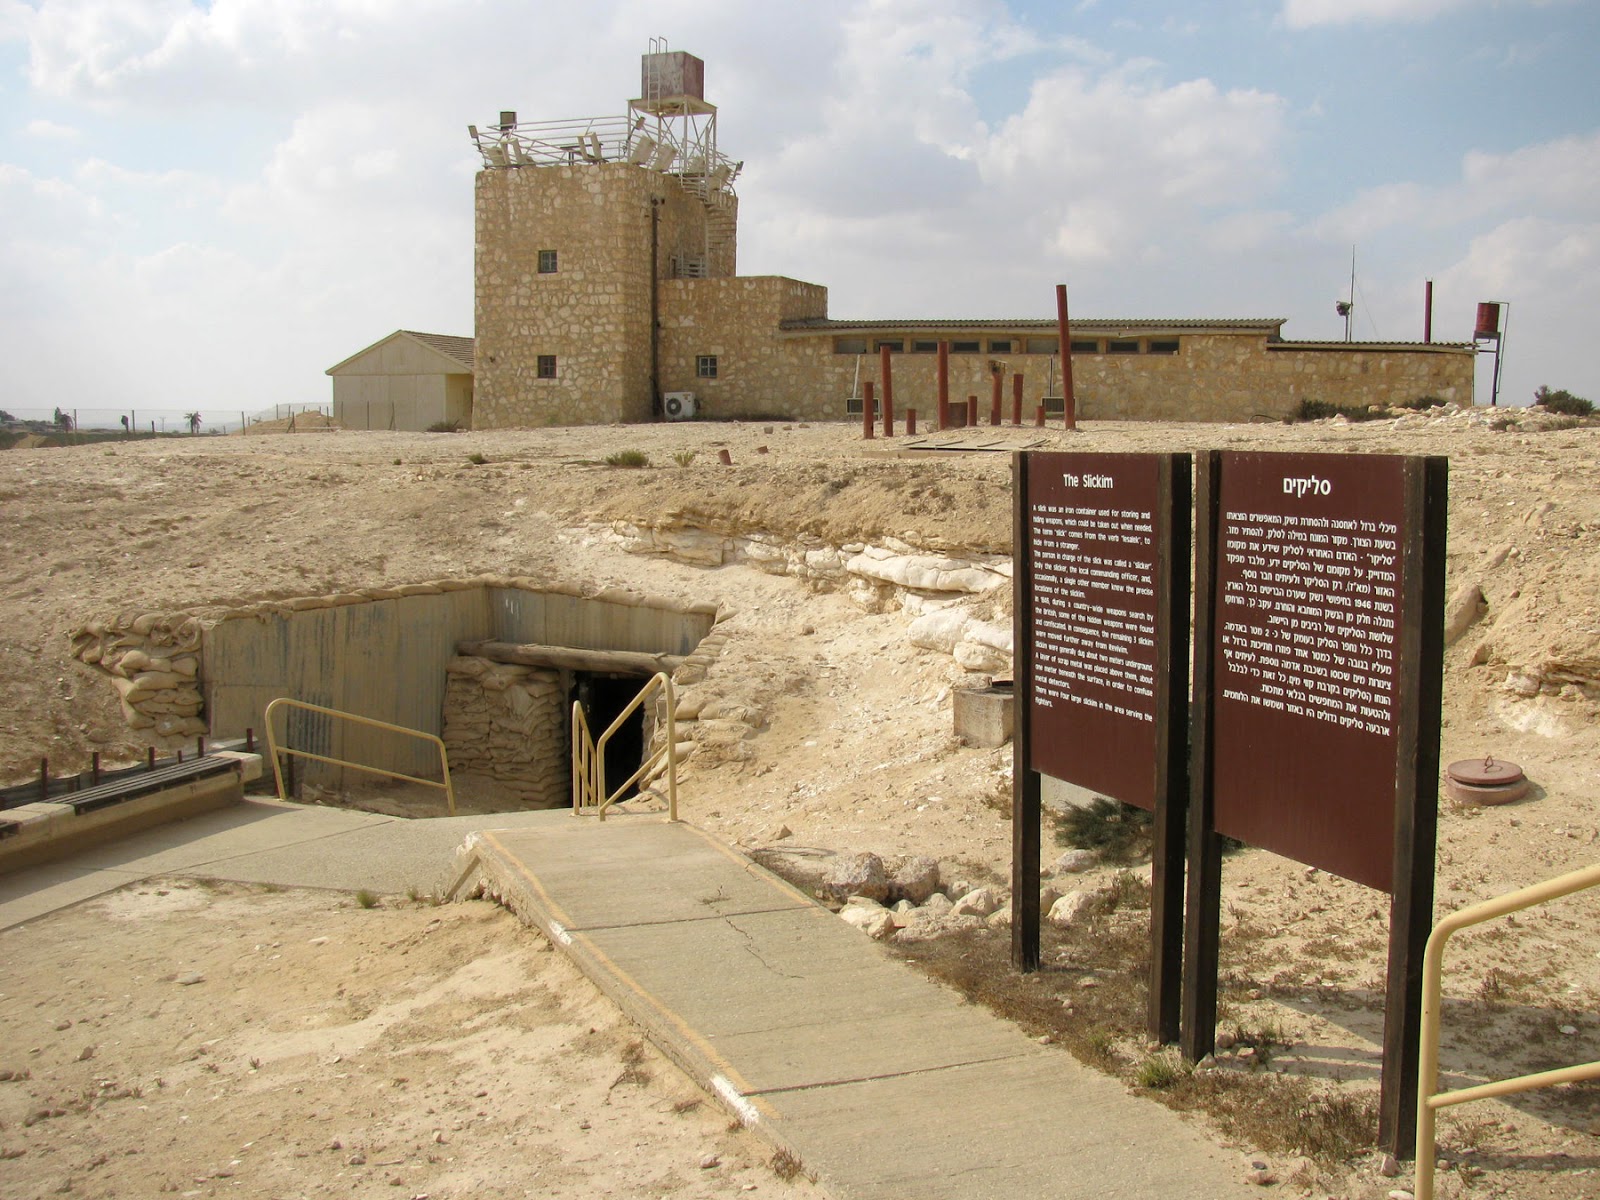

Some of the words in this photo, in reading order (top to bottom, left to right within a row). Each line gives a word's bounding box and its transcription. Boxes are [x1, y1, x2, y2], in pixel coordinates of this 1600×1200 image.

[1063, 474, 1078, 487] The
[1083, 474, 1113, 488] Slickim
[1284, 475, 1331, 498] סליקים
[1037, 504, 1047, 512] slick
[1065, 506, 1075, 514] iron
[1075, 507, 1097, 516] container
[1098, 509, 1110, 517] used
[1121, 510, 1139, 520] storing
[1300, 517, 1329, 528] ולהסתרת
[1360, 520, 1376, 532] ברזל
[1378, 521, 1397, 534] מיכלי
[1042, 528, 1053, 536] term
[1068, 531, 1083, 539] comes
[1084, 531, 1096, 540] from
[1108, 534, 1119, 542] verb
[1241, 527, 1264, 537] להסתיר
[1287, 530, 1307, 541] במילה
[1309, 533, 1329, 543] המונח
[1227, 540, 1247, 551] מקומו
[1331, 535, 1348, 546] מקור
[1374, 539, 1396, 550] בשעת
[1262, 543, 1280, 553] שידע
[1282, 544, 1304, 556] לסליק
[1306, 548, 1334, 559] האחראי
[1062, 553, 1076, 563] charge
[1092, 556, 1102, 565] slick
[1114, 559, 1127, 568] called
[1226, 553, 1245, 564] מפקד
[1247, 555, 1265, 566] מלבד
[1336, 551, 1357, 562] האדם
[1282, 559, 1311, 571] הסליקים
[1326, 565, 1351, 577] מקומם
[1078, 566, 1089, 575] local
[1090, 569, 1120, 580] commanding
[1260, 571, 1273, 581] חבר
[1275, 573, 1300, 584] ולעיתים
[1064, 577, 1076, 586] single
[1077, 579, 1090, 587] other
[1091, 581, 1110, 590] member
[1111, 583, 1124, 592] knew
[1136, 587, 1153, 596] precise
[1245, 581, 1258, 593] בכל
[1303, 576, 1329, 588] הסליקר
[1259, 585, 1285, 597] הבריטים
[1286, 589, 1307, 600] שערכו
[1374, 585, 1395, 598] האזור
[1309, 592, 1324, 603] נשק
[1326, 594, 1352, 607] בחיפושי
[1354, 599, 1372, 609] 1946
[1374, 601, 1394, 613] בשנת
[1058, 611, 1070, 619] some
[1087, 615, 1102, 625] hidden
[1103, 619, 1124, 629] weapons
[1125, 623, 1138, 631] were
[1139, 624, 1154, 634] found
[1300, 620, 1322, 632] רביבים
[1250, 625, 1263, 636] מטר
[1337, 626, 1366, 639] הסליקים
[1293, 633, 1315, 645] בעומק
[1317, 637, 1339, 649] הסליק
[1368, 631, 1394, 644] שלושת
[1341, 641, 1357, 653] נחפר
[1359, 642, 1373, 656] כלל
[1375, 648, 1392, 660] בדרך
[1040, 652, 1050, 661] layer
[1057, 657, 1069, 666] scrap
[1070, 660, 1083, 669] metal
[1094, 665, 1108, 674] placed
[1109, 668, 1123, 678] above
[1139, 674, 1153, 685] about
[1044, 665, 1057, 674] meter
[1058, 668, 1076, 679] beneath
[1112, 681, 1125, 690] order
[1134, 686, 1153, 697] confuse
[1286, 689, 1306, 702] בגלאי
[1048, 689, 1059, 698] were
[1060, 691, 1070, 700] four
[1071, 694, 1082, 704] large
[1083, 697, 1098, 707] slickim
[1114, 706, 1125, 715] area
[1126, 709, 1143, 720] serving
[1263, 698, 1284, 710] ושמשו
[1308, 694, 1343, 710] המחפשים
[1286, 703, 1304, 715] באזור
[1306, 708, 1315, 718] היו
[1360, 706, 1391, 721] ולהטעות
[1317, 710, 1337, 723] גדולים
[1339, 716, 1364, 729] סליקים
[1365, 722, 1390, 736] ארבעה
